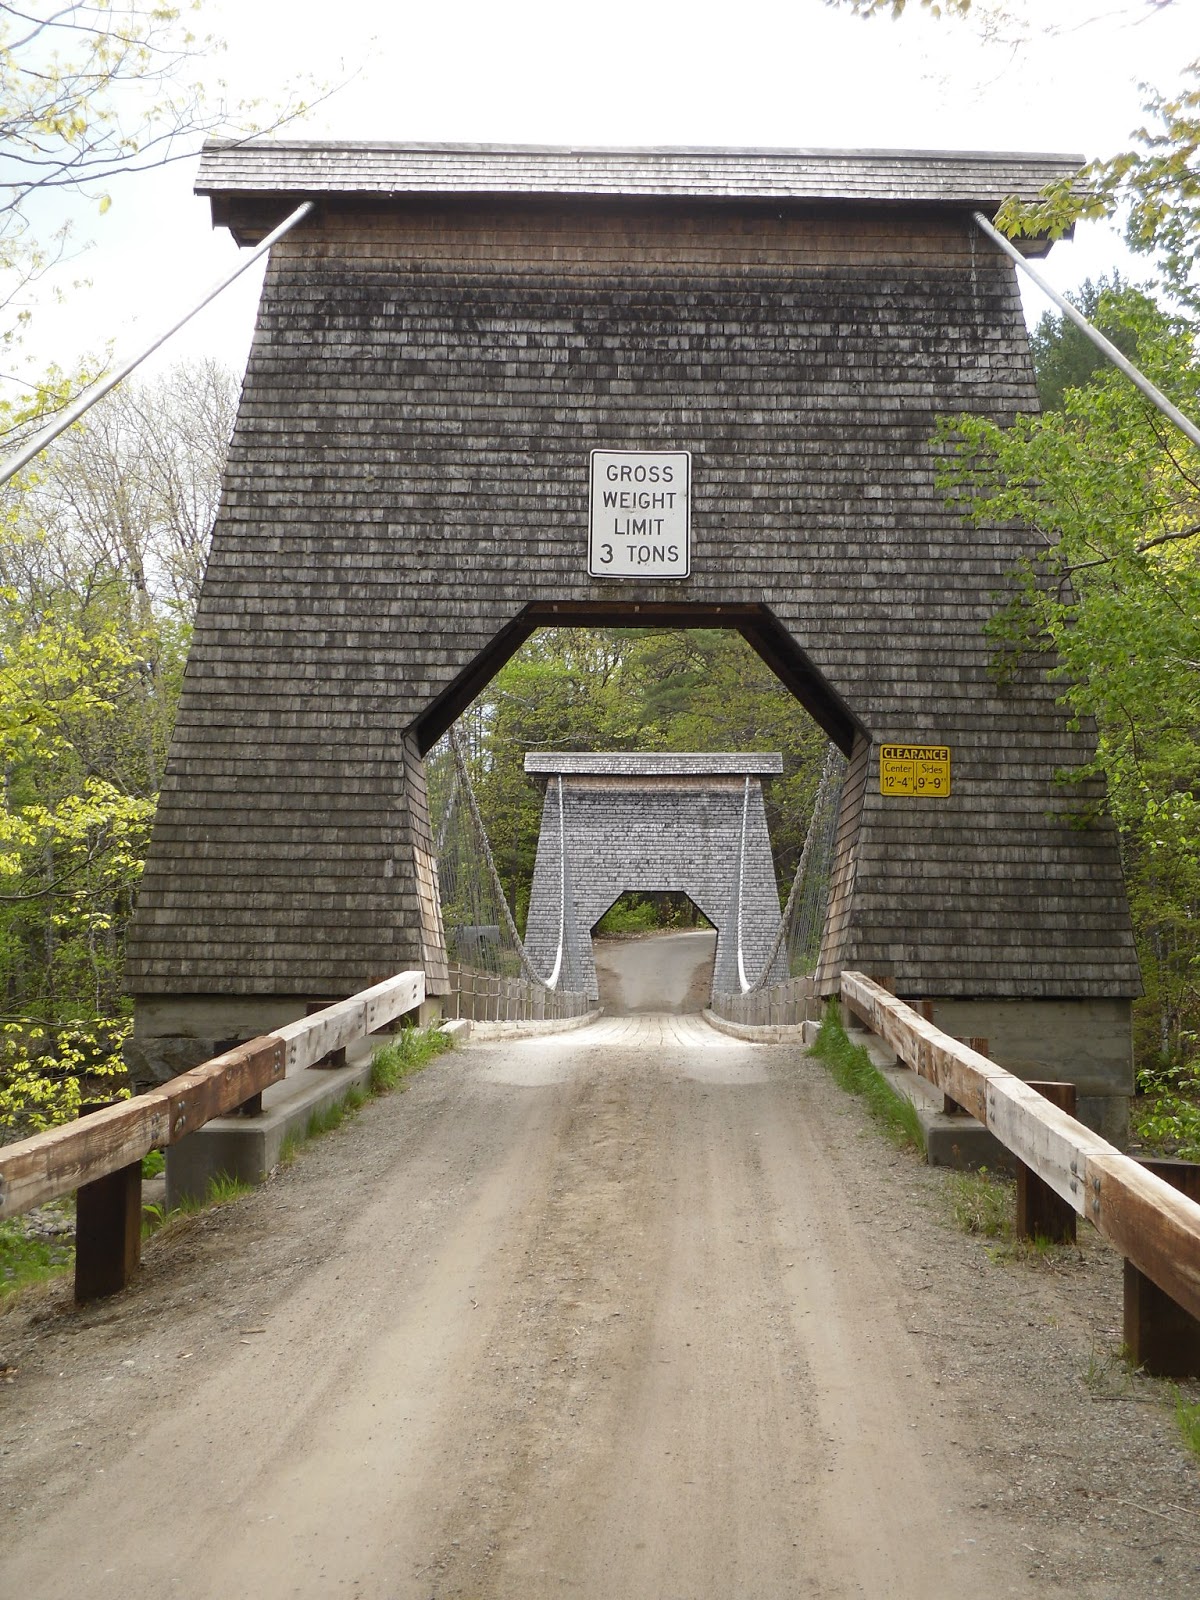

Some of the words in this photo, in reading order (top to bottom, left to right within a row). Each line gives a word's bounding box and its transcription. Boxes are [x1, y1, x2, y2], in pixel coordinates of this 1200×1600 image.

[606, 464, 674, 483] GROSS
[603, 491, 677, 509] WEIGHT
[614, 518, 665, 536] LIMIT
[599, 543, 614, 564] 3
[626, 545, 679, 563] TONS
[883, 748, 947, 760] CLEARANCE
[884, 762, 912, 773] Center
[921, 763, 943, 774] Sides
